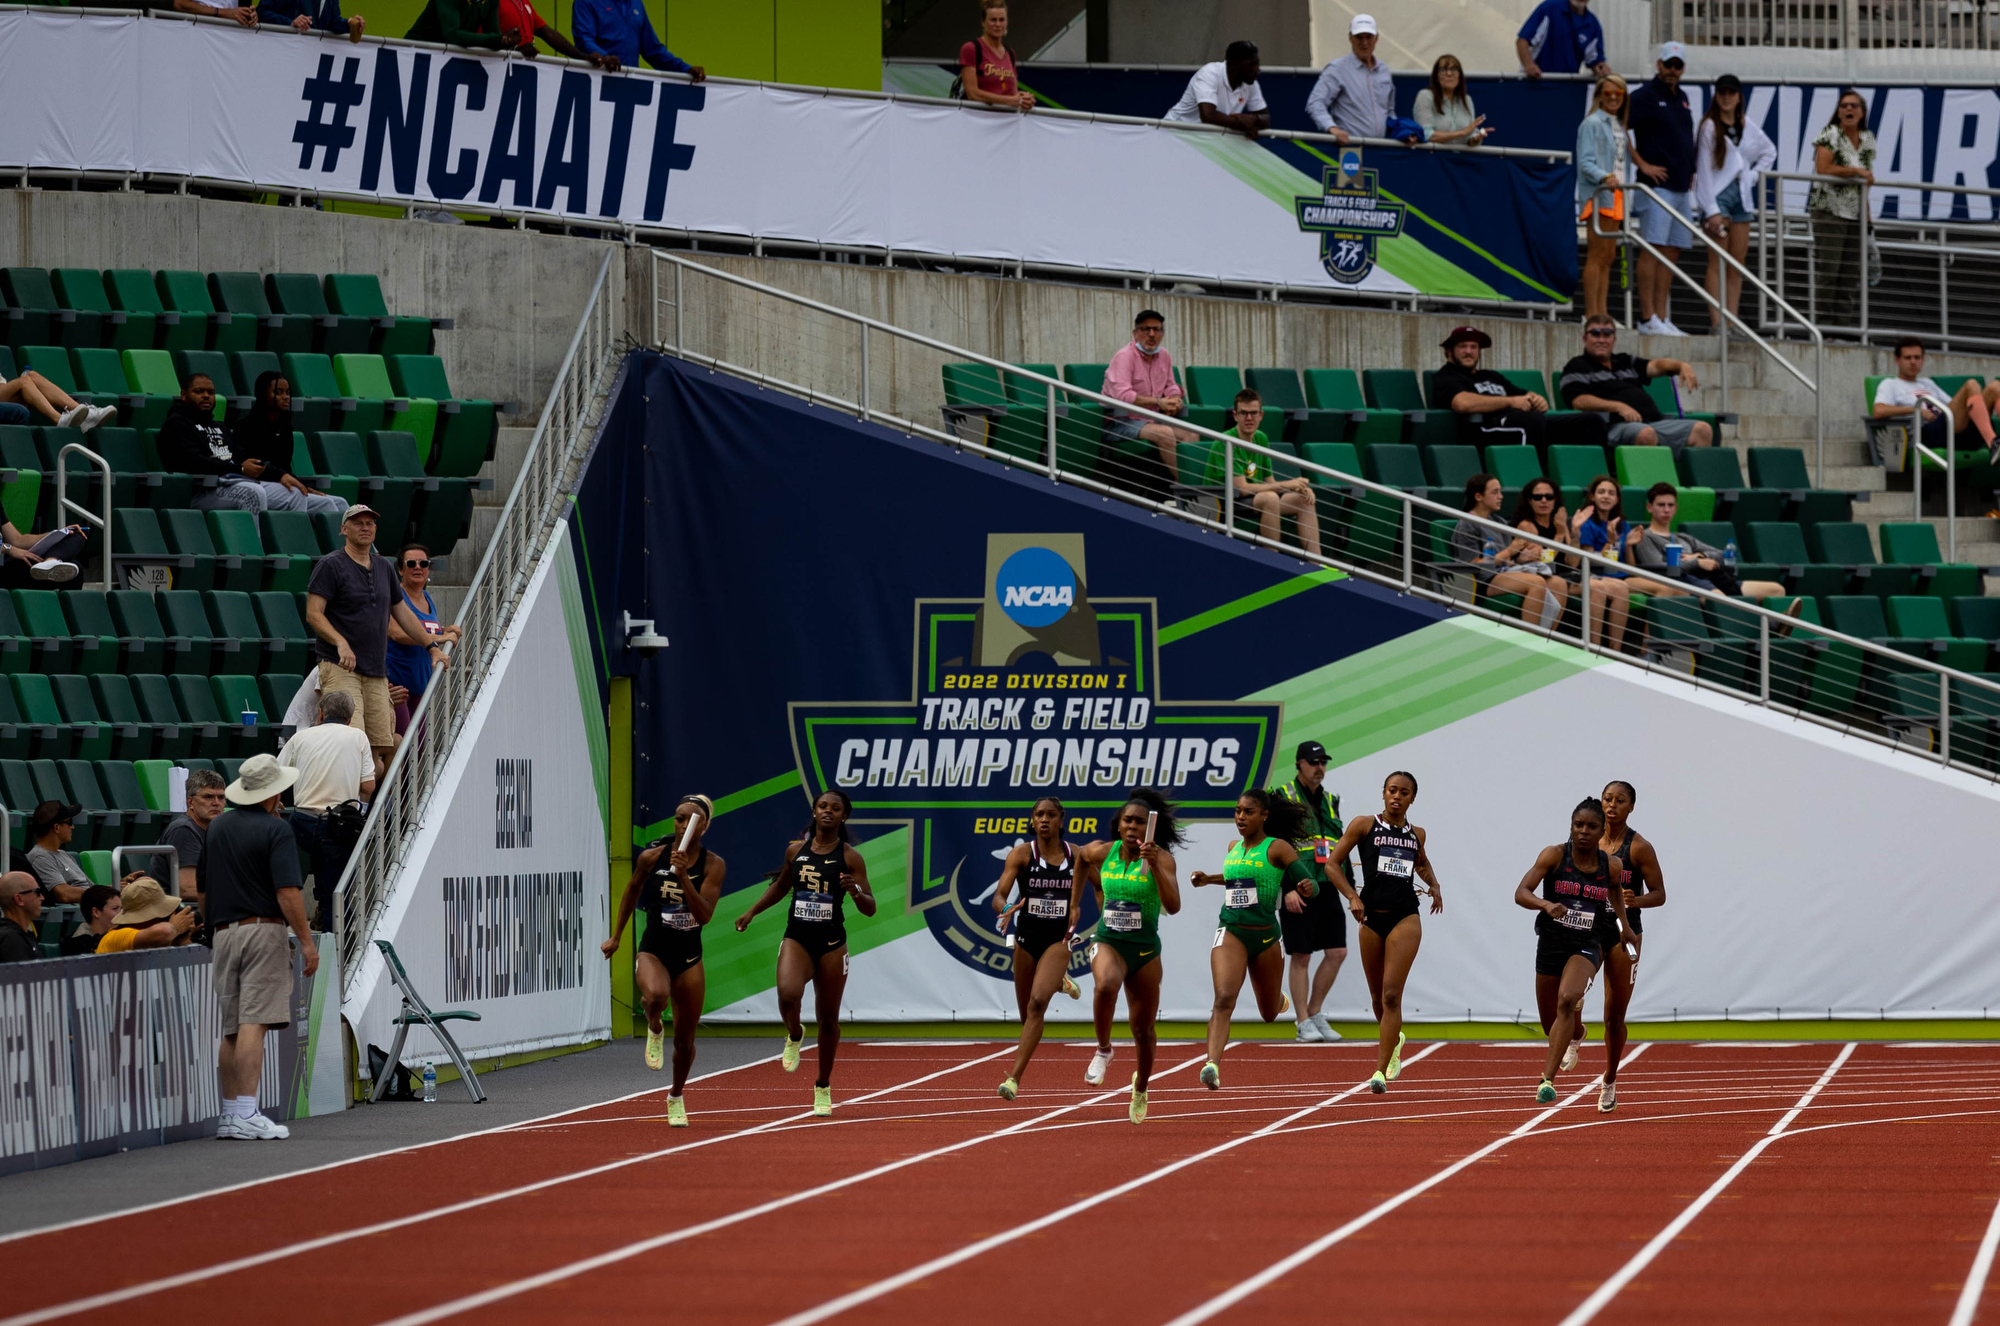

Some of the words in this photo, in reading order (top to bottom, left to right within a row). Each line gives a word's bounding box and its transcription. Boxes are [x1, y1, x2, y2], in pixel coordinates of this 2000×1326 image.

[292, 48, 706, 222] #NCAATF
[1324, 196, 1348, 208] TRACK
[1355, 198, 1377, 210] FIELD
[1304, 206, 1397, 229] CHAMPIONSHIPS
[152, 569, 165, 581] 128
[1003, 586, 1073, 607] NCAA
[943, 674, 998, 689] 2022
[1005, 674, 1109, 689] DIVISION
[1115, 674, 1127, 689] I
[922, 697, 1025, 731] TRACK
[1030, 697, 1056, 731] &
[1062, 697, 1151, 731] FIELD
[835, 738, 1240, 787] CHAMPIONSHIPS
[495, 758, 515, 849] 2022
[1068, 817, 1098, 834] OR
[1374, 836, 1419, 851] CAROLINA
[1383, 863, 1408, 875] FRANK
[1029, 878, 1073, 889] CAROLIN
[1554, 880, 1581, 896] OHIO
[1583, 884, 1608, 901] STAT
[1231, 895, 1249, 905] REED
[795, 907, 832, 919] SEYMOUR
[1031, 904, 1065, 915] FRASIER
[1103, 917, 1141, 928] MONTGOMERY
[1555, 914, 1593, 928] ERTRAND
[442, 876, 474, 1004] TRACK
[485, 875, 511, 999] FIELD
[513, 870, 584, 996] CHAMPIONSHIPS
[1213, 929, 1223, 946] 7
[73, 969, 119, 1143] TRACK
[136, 967, 183, 1132] FIELD
